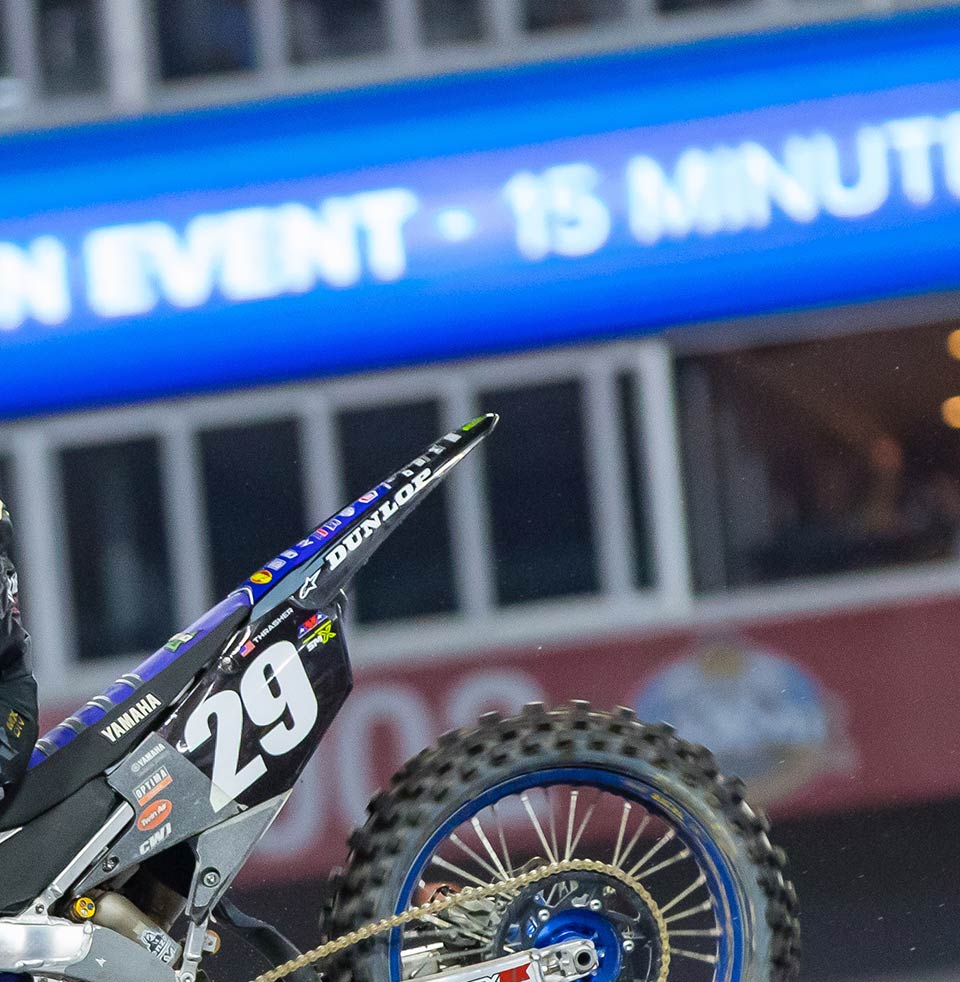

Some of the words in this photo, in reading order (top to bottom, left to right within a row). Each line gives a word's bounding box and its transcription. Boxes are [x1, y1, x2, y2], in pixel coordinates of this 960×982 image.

[80, 190, 416, 317] EVENT
[325, 467, 432, 571] DUNLOP
[252, 607, 295, 644] THRASHER
[100, 692, 163, 744] YAMAHA
[183, 640, 319, 813] 29
[137, 743, 166, 767] YAMAHA
[135, 769, 167, 799] OPTIMA
